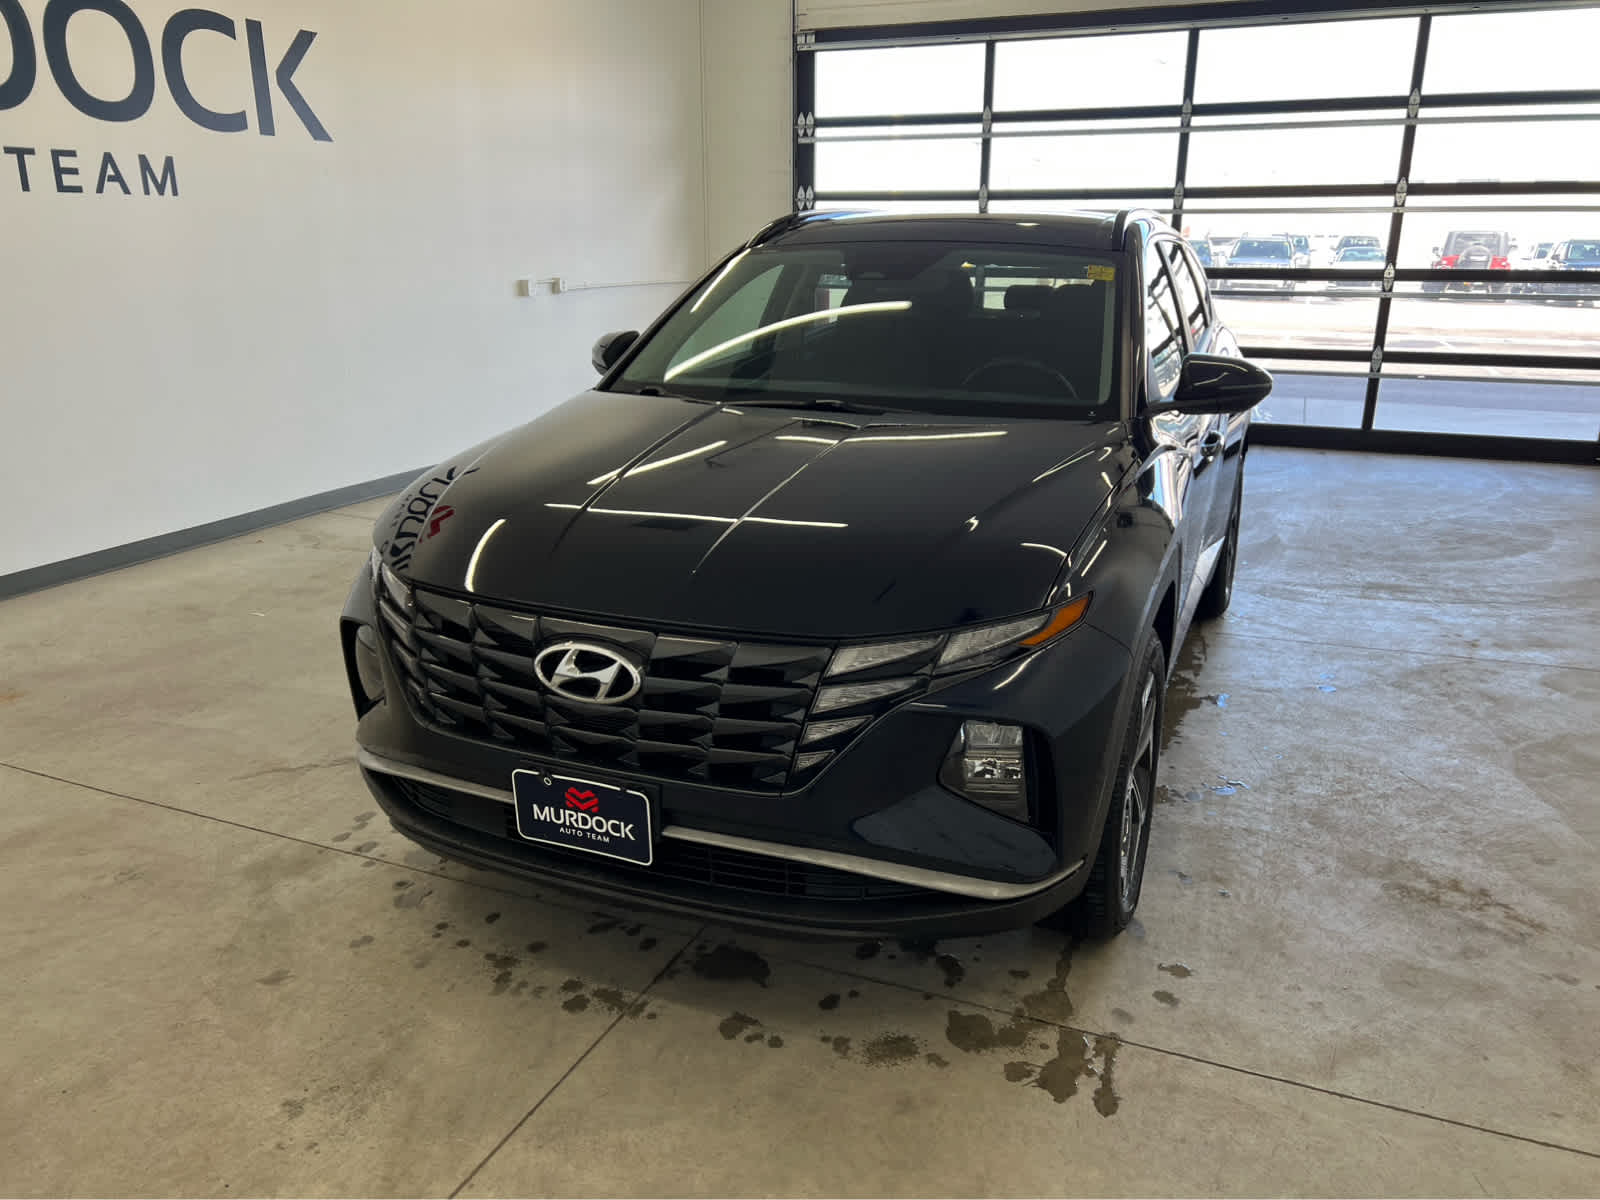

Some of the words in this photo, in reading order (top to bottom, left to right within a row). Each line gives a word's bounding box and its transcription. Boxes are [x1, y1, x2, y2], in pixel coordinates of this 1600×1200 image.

[3, 146, 179, 197] TEAM
[532, 804, 636, 841] MURDOCK
[559, 826, 583, 837] AUTO
[586, 832, 610, 843] TEAM
